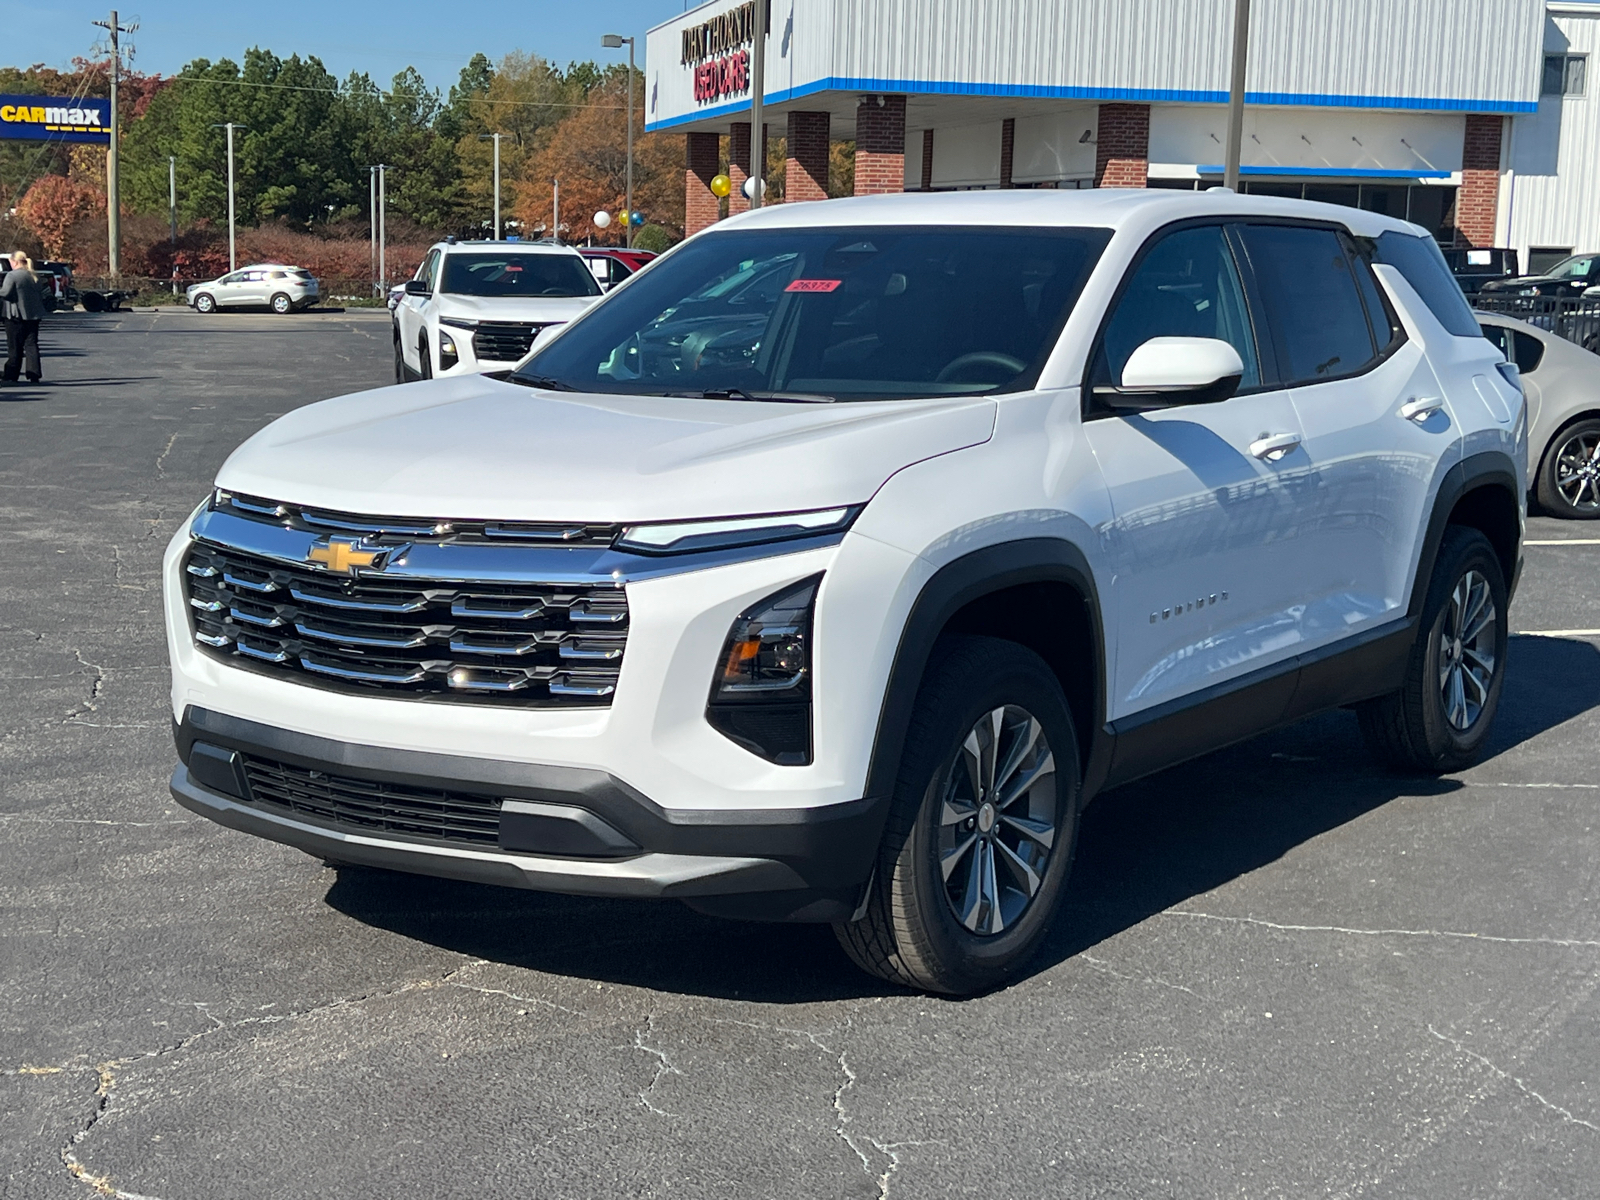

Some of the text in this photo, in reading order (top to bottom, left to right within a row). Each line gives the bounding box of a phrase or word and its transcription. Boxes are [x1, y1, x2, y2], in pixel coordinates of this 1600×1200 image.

[707, 1, 755, 54] THORNTO
[694, 49, 747, 101] USED CARS
